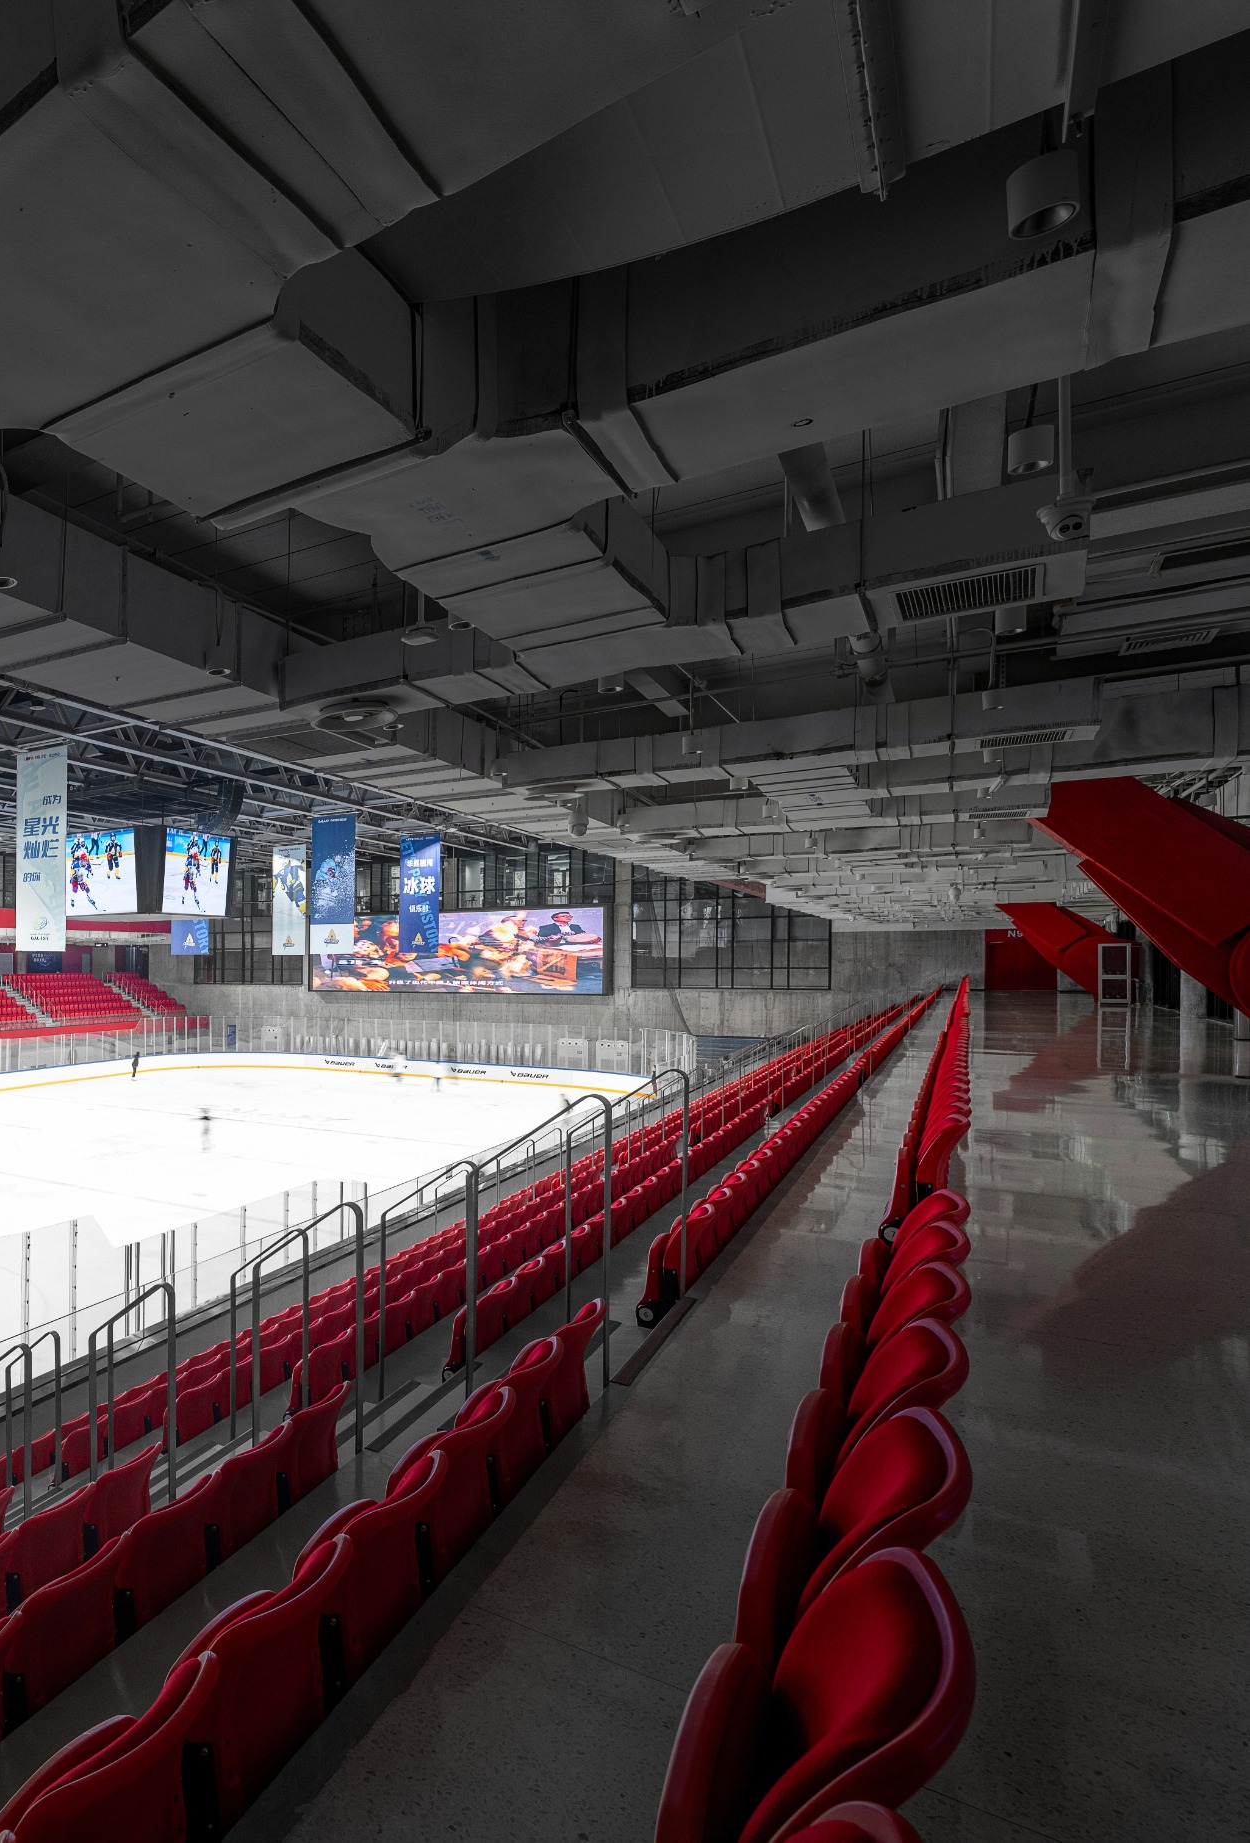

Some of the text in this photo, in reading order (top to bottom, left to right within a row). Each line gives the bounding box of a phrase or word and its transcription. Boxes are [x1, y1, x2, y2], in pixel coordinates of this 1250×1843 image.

[42, 795, 62, 805] 成为
[23, 816, 59, 837] 星光
[23, 839, 59, 859] 灿烂
[403, 875, 436, 895] 冰球
[409, 904, 429, 913] 俱乐部
